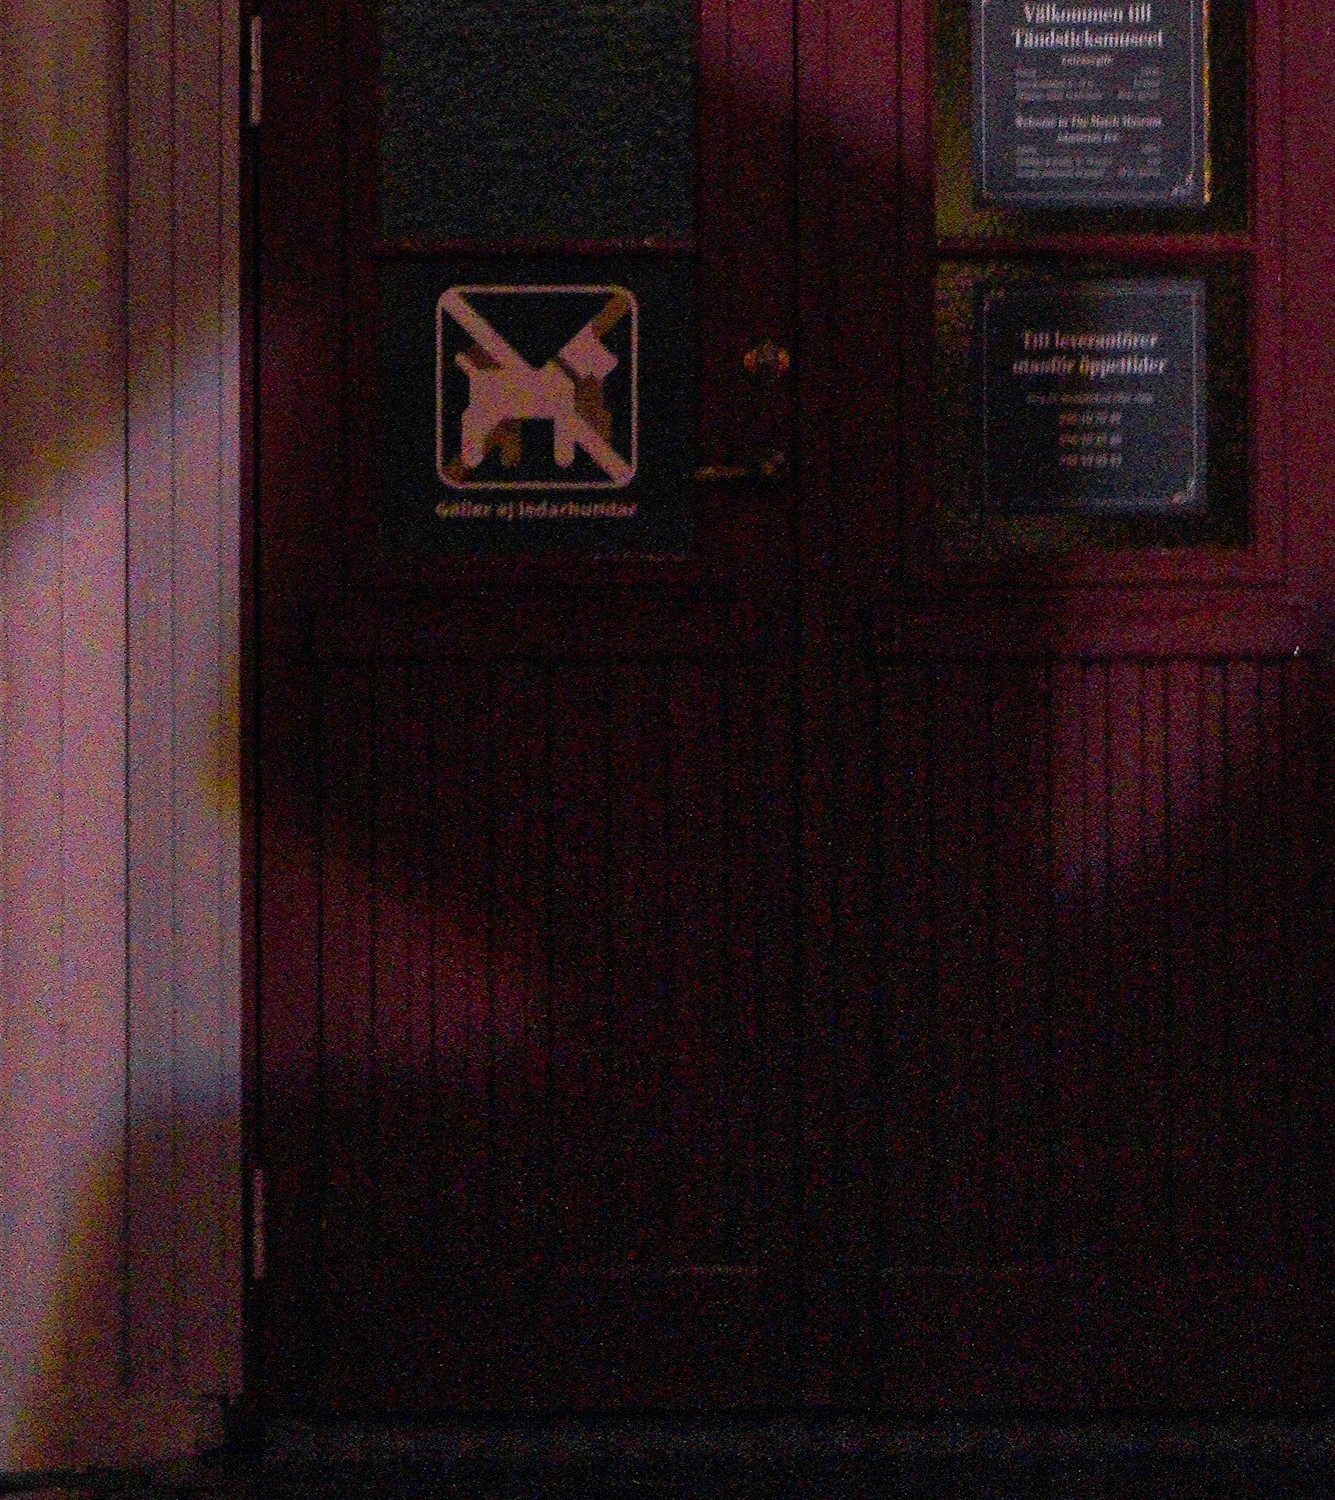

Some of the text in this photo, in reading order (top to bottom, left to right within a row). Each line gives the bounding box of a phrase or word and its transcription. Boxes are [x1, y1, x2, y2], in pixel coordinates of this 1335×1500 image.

[1023, 2, 1152, 24] Välkommen till
[1012, 28, 1165, 48] Tändsticksmuseet
[1021, 330, 1050, 350] Till
